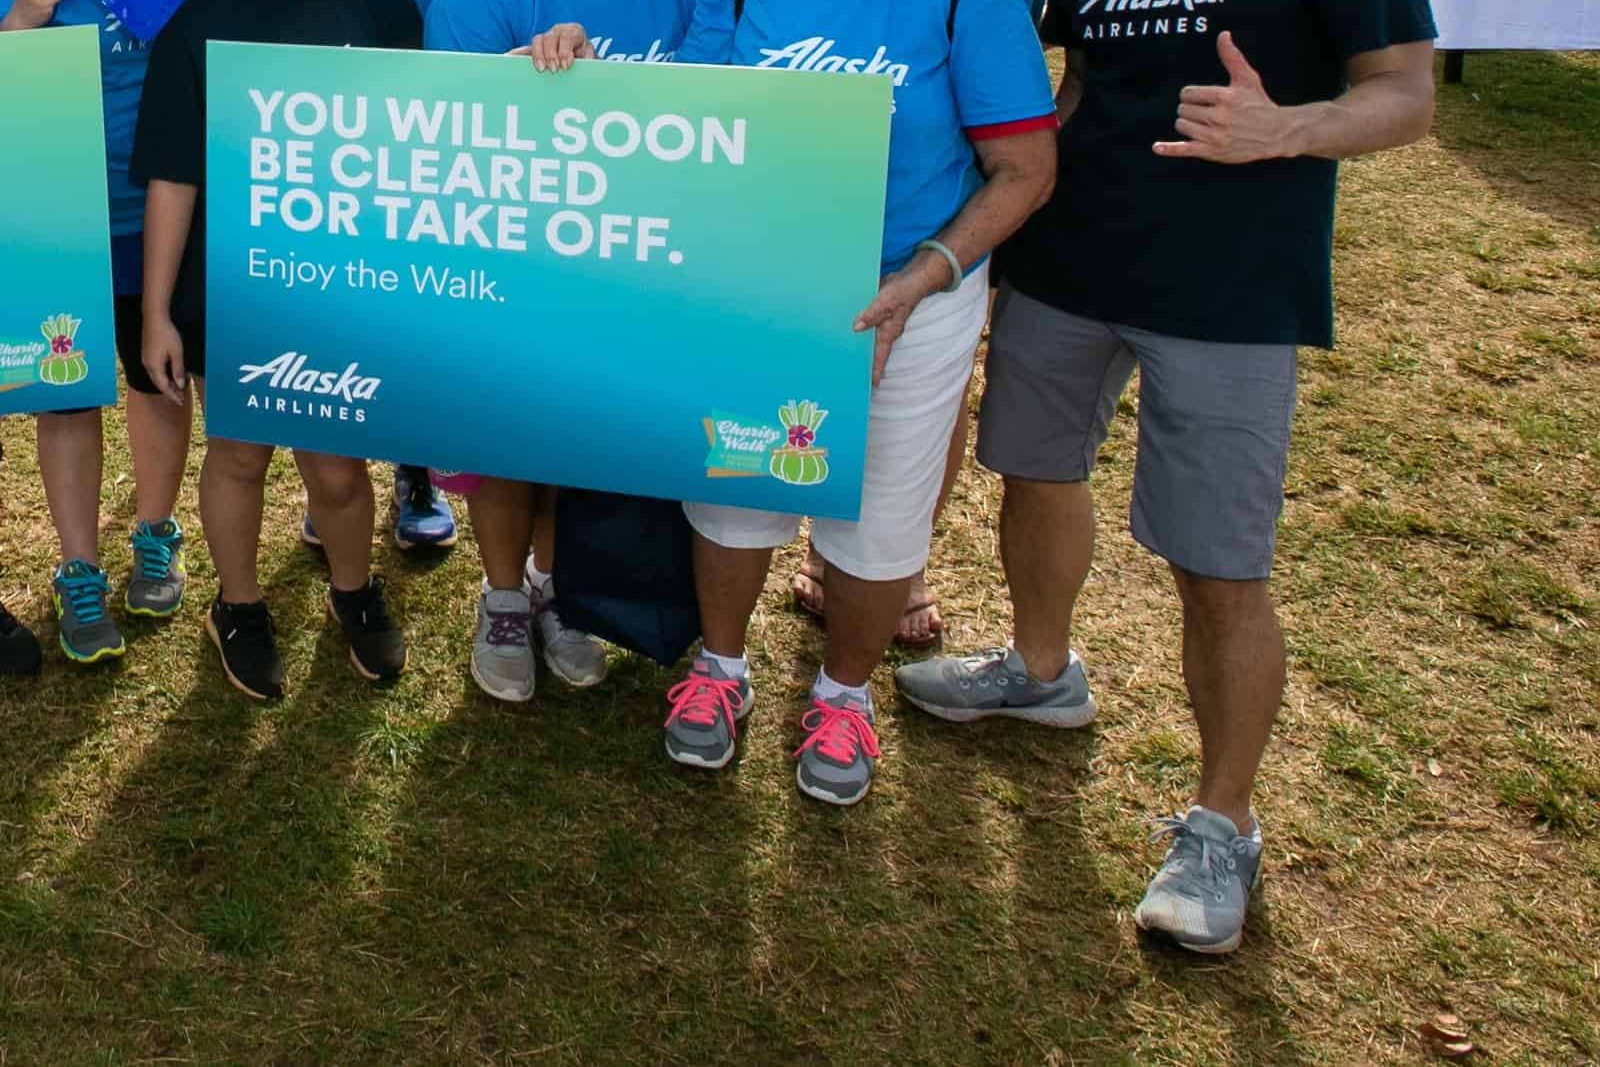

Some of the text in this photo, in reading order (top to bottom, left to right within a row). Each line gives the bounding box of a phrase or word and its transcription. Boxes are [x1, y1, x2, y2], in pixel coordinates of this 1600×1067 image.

[1083, 16, 1209, 39] AIRLINES
[248, 89, 746, 165] YOU WILL SOON
[249, 135, 608, 206] BE CLEARED
[249, 184, 684, 265] FOR TAKE OFF.
[248, 247, 505, 303] Enjoy the Walk.
[238, 351, 382, 404] Alaska
[246, 394, 366, 423] AIRLINES
[716, 420, 780, 444] Charity
[721, 436, 767, 452] Walk
